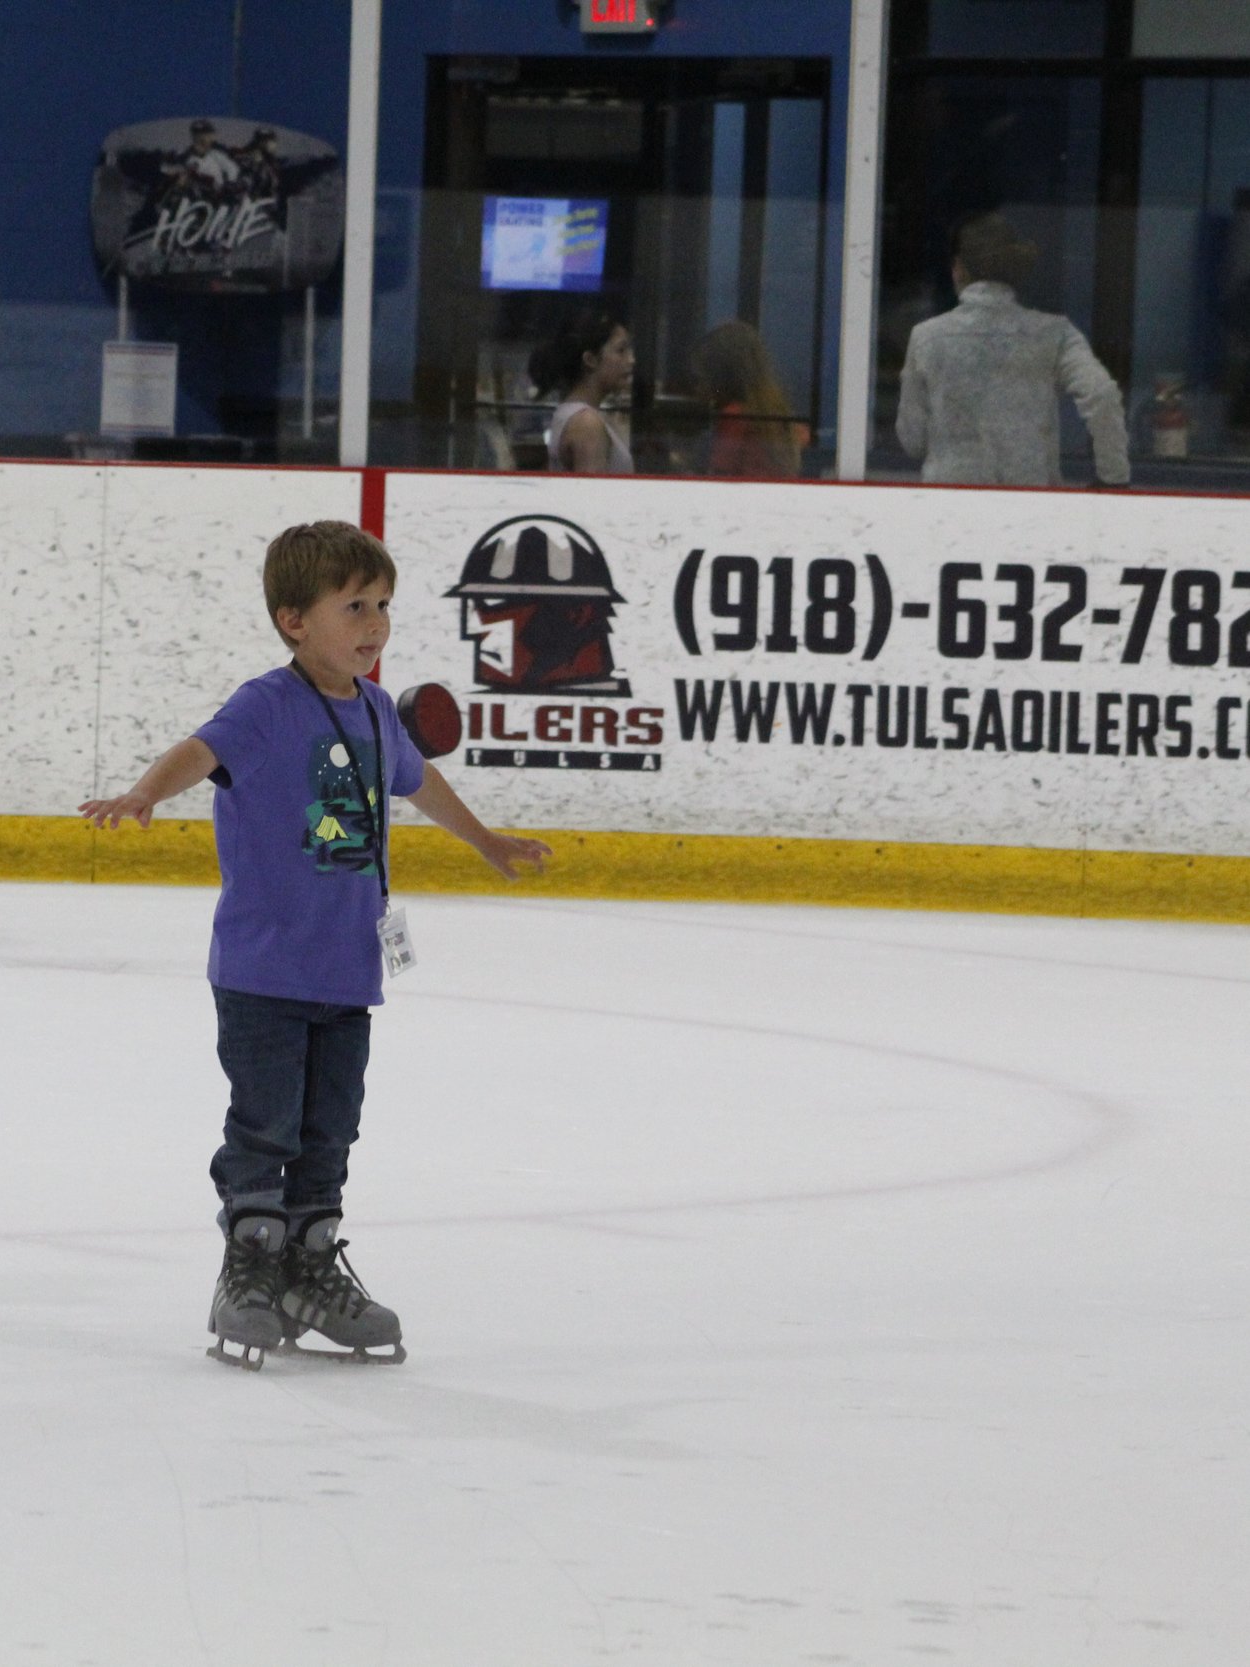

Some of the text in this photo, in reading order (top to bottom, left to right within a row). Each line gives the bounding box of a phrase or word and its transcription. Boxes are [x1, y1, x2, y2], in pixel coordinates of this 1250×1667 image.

[124, 196, 278, 251] HOME
[674, 678, 1250, 760] WWW.TULSAOILERS.C
[470, 750, 656, 770] TULSA
